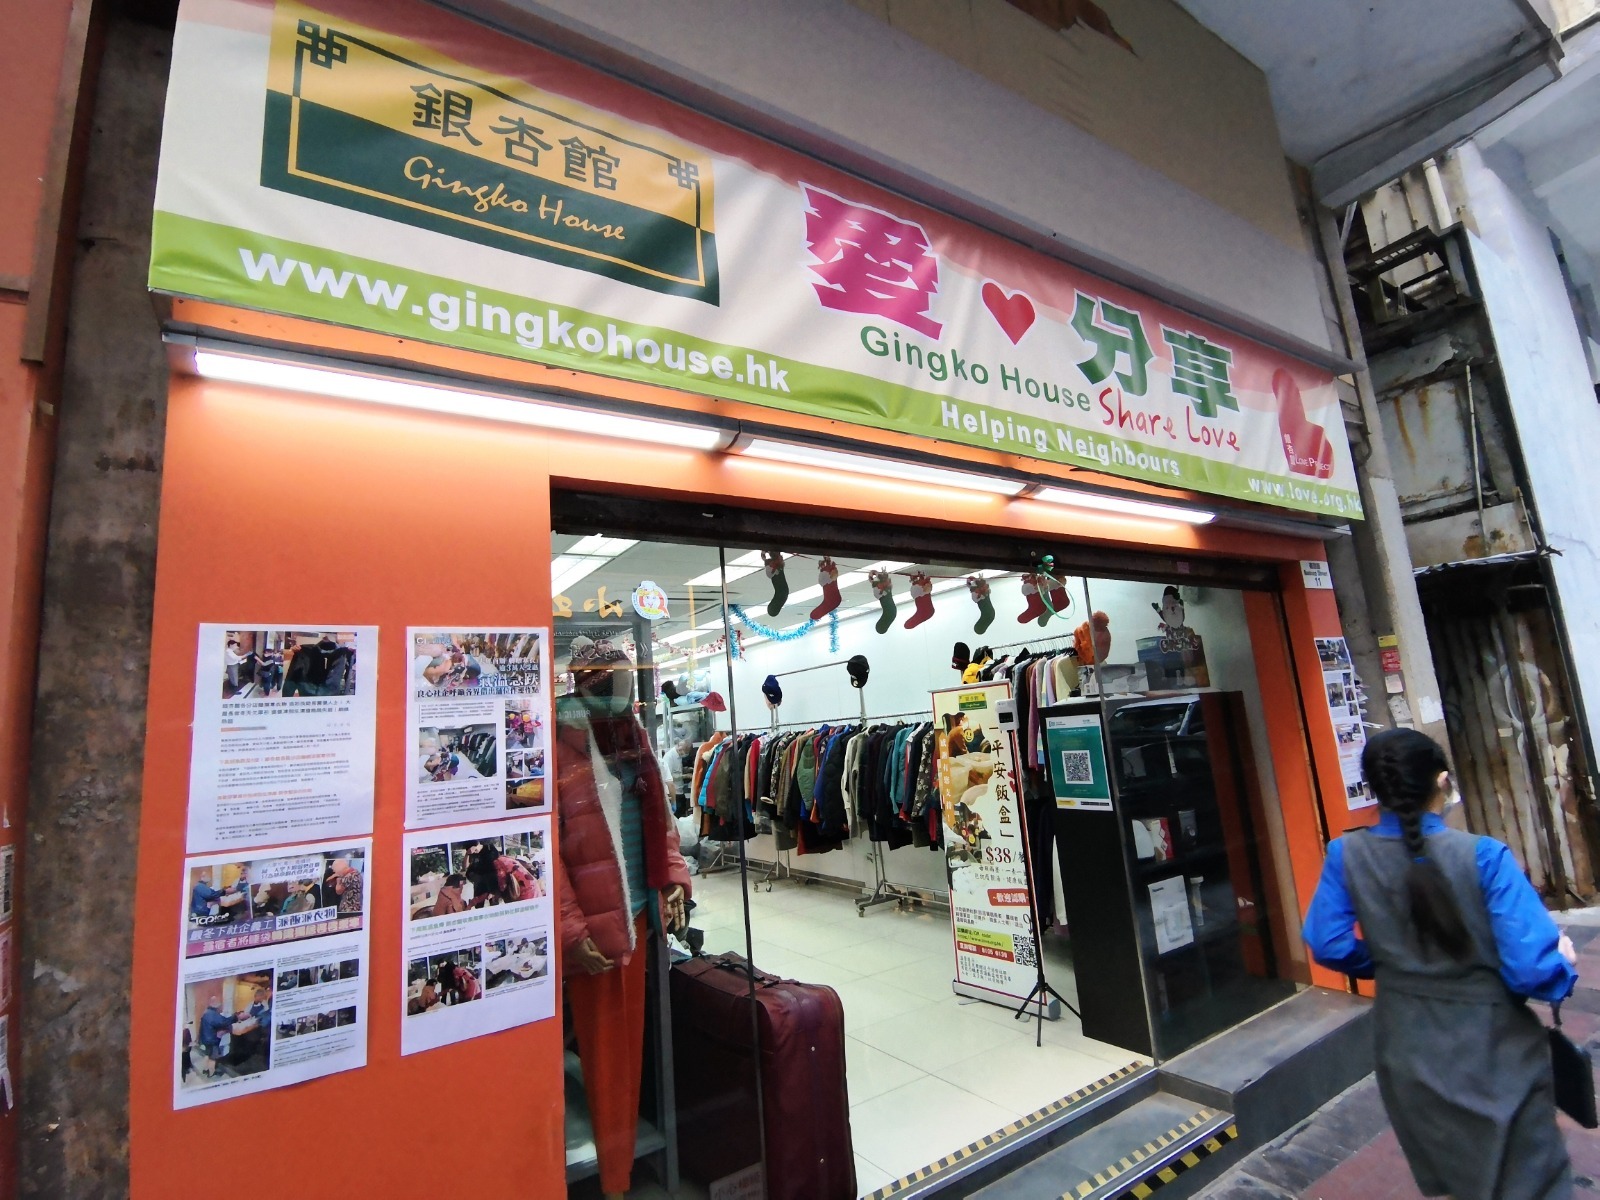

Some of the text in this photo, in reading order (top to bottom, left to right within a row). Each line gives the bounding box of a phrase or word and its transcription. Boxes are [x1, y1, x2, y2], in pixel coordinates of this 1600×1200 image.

[410, 82, 621, 193] 銀杏館
[403, 156, 625, 241] Gingko House
[238, 247, 790, 394] www.gingkohouse.hk
[1071, 291, 1239, 418] 分享
[860, 325, 1240, 453] Gingko House Share Love
[941, 404, 1180, 477] Helping Neighbours
[1247, 475, 1362, 513] www.love.org.hk
